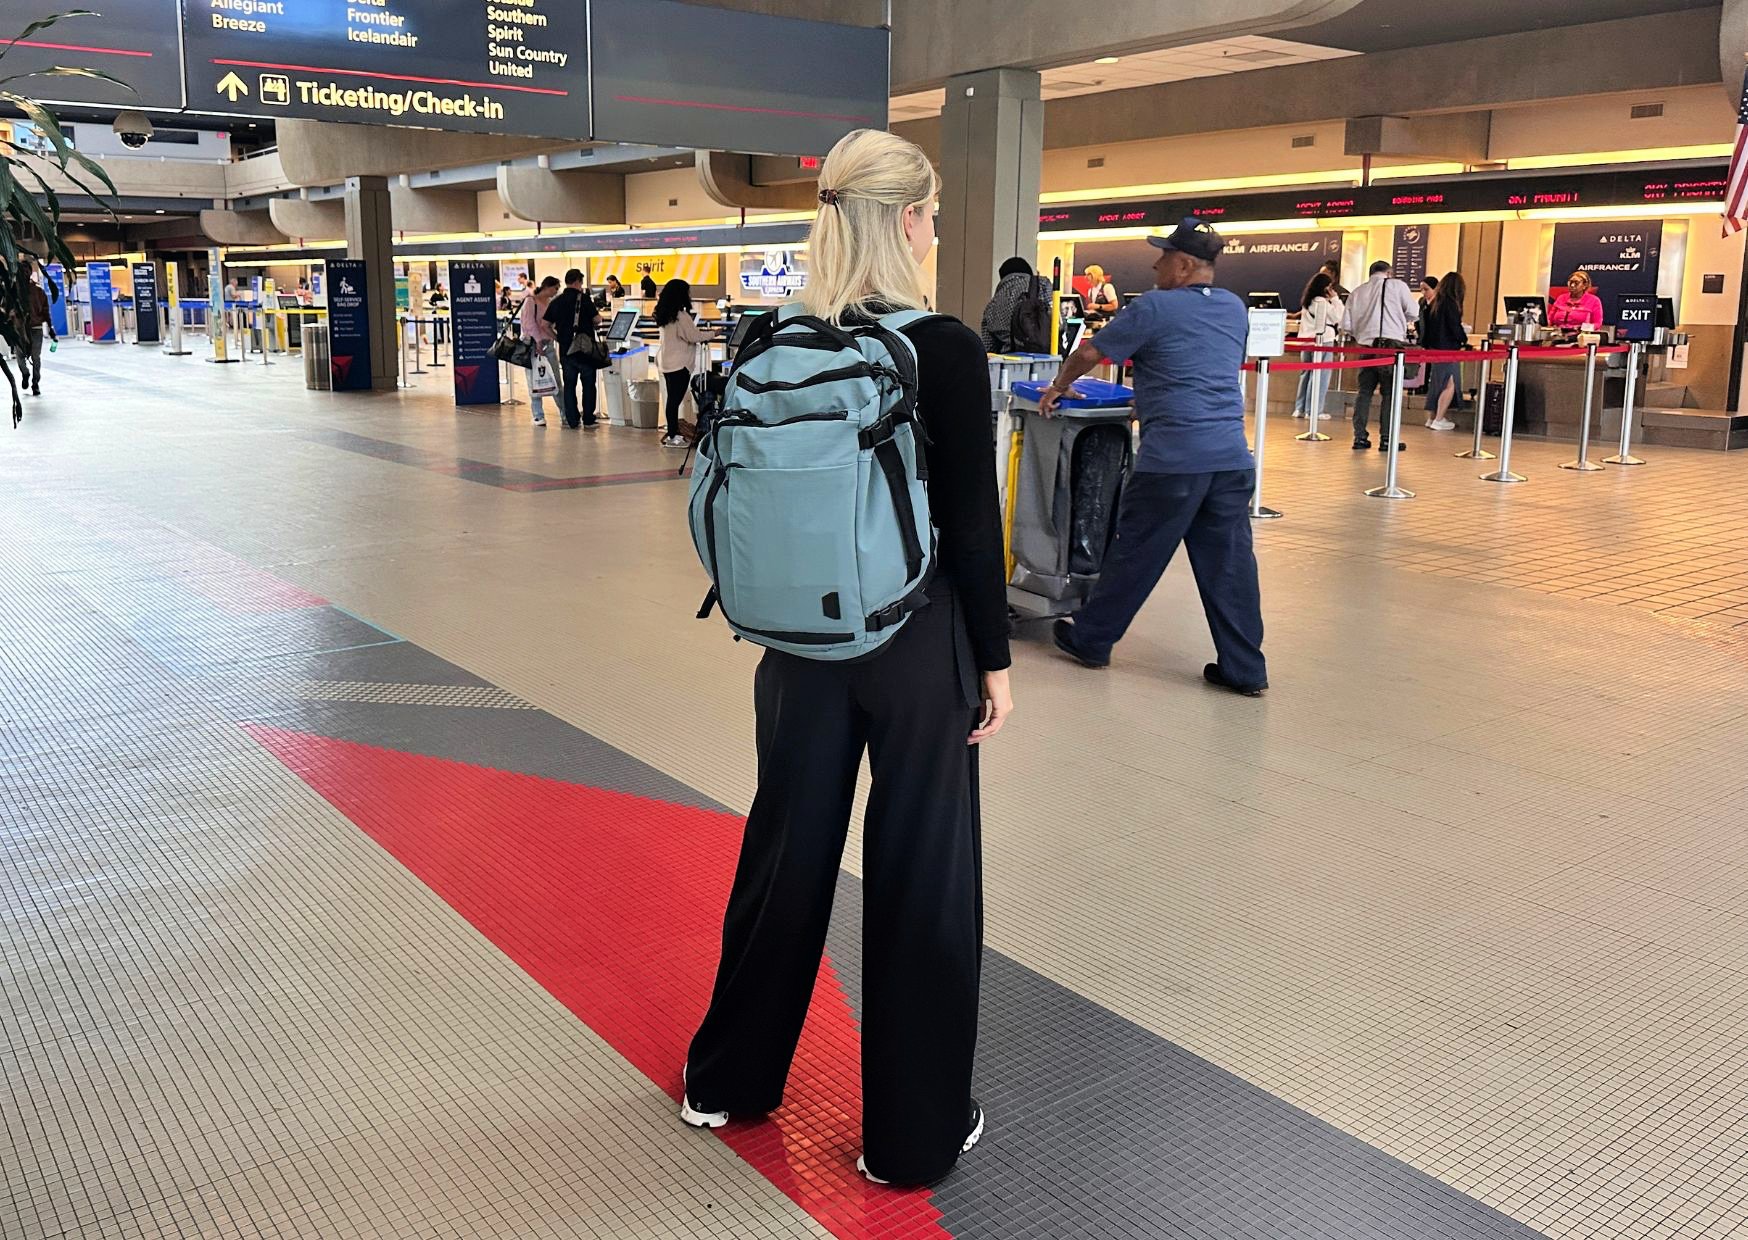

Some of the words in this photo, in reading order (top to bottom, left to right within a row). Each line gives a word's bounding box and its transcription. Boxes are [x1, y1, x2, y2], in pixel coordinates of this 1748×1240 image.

[211, 0, 284, 15] Allegiant
[487, 5, 547, 26] Southern
[212, 13, 266, 33] Breeze
[347, 8, 405, 27] Frontier
[348, 26, 418, 47] Icelandair
[487, 23, 523, 42] Spirit
[488, 42, 513, 58] Sun
[516, 45, 567, 67] Country
[489, 60, 533, 78] United
[296, 81, 504, 120] Ticketing/Check-in
[1223, 245, 1245, 254] KLM
[1249, 242, 1309, 254] AIRFRANCE
[1622, 310, 1651, 320] EXIT
